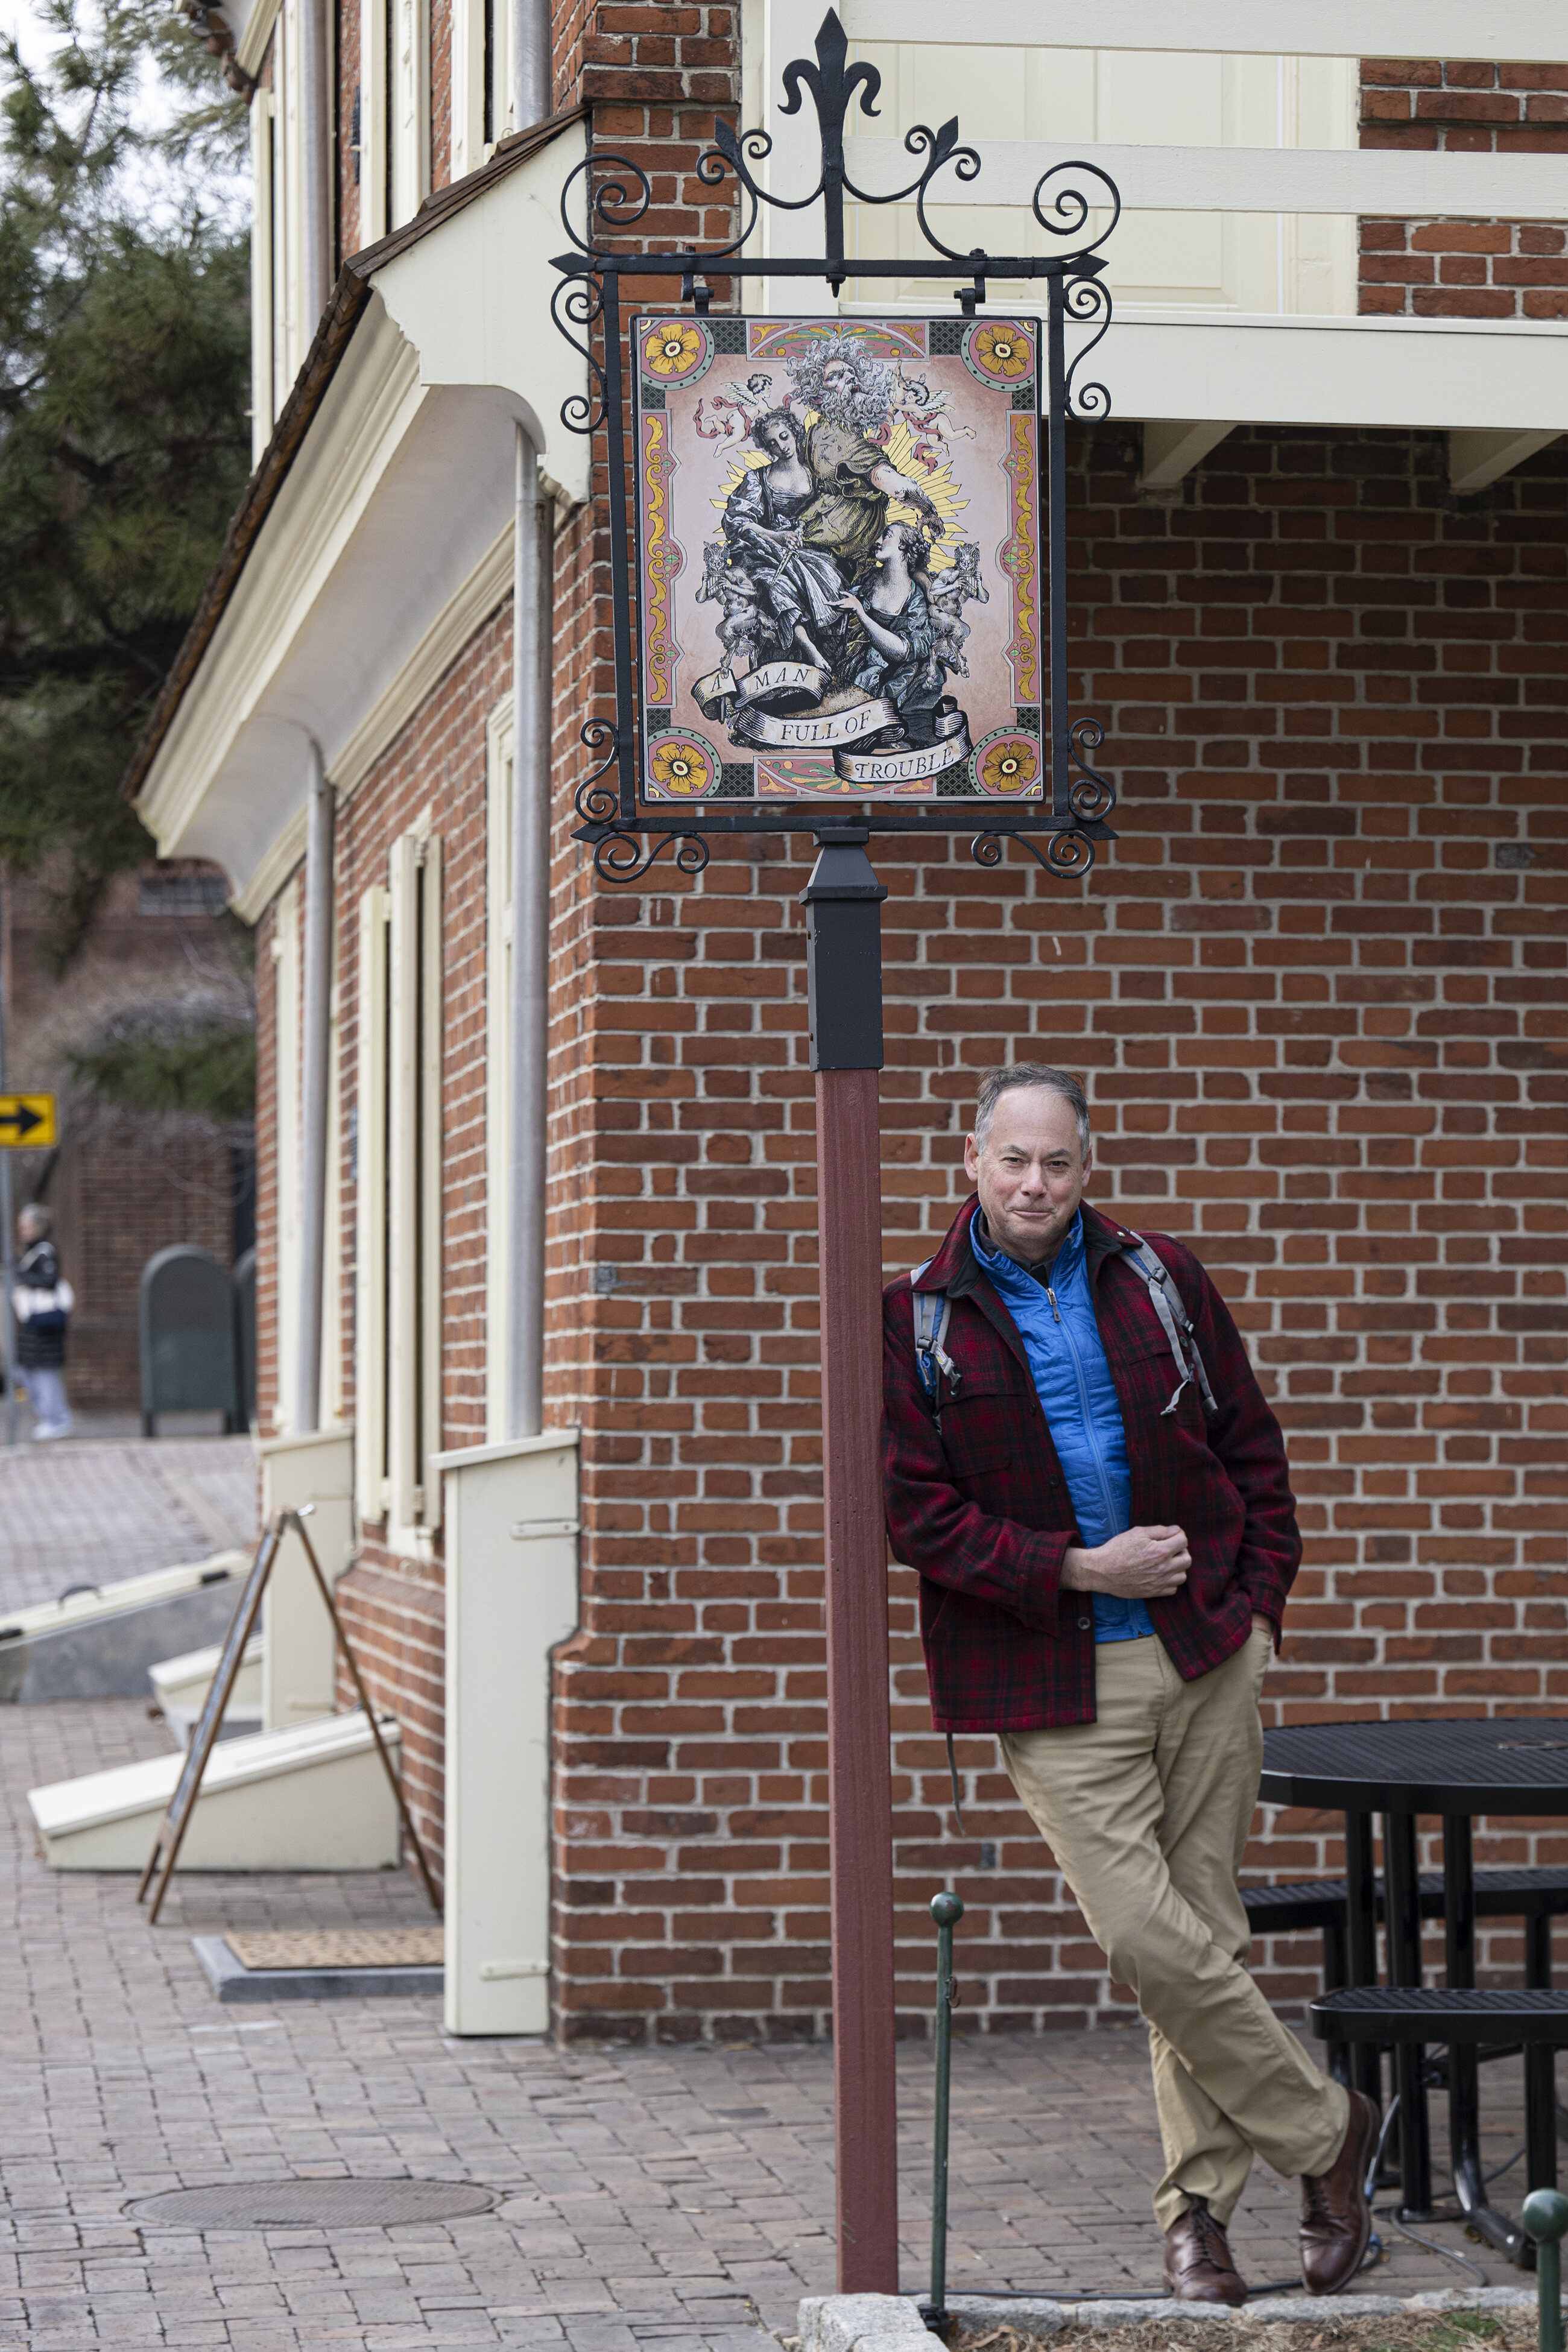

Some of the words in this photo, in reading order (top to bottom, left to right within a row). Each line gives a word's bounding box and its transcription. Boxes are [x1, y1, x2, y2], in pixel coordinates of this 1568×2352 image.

[710, 673, 722, 694] A
[753, 667, 811, 691] MAN
[780, 722, 839, 741] FULL
[845, 709, 872, 734] OF
[855, 745, 954, 779] TROUBLE
